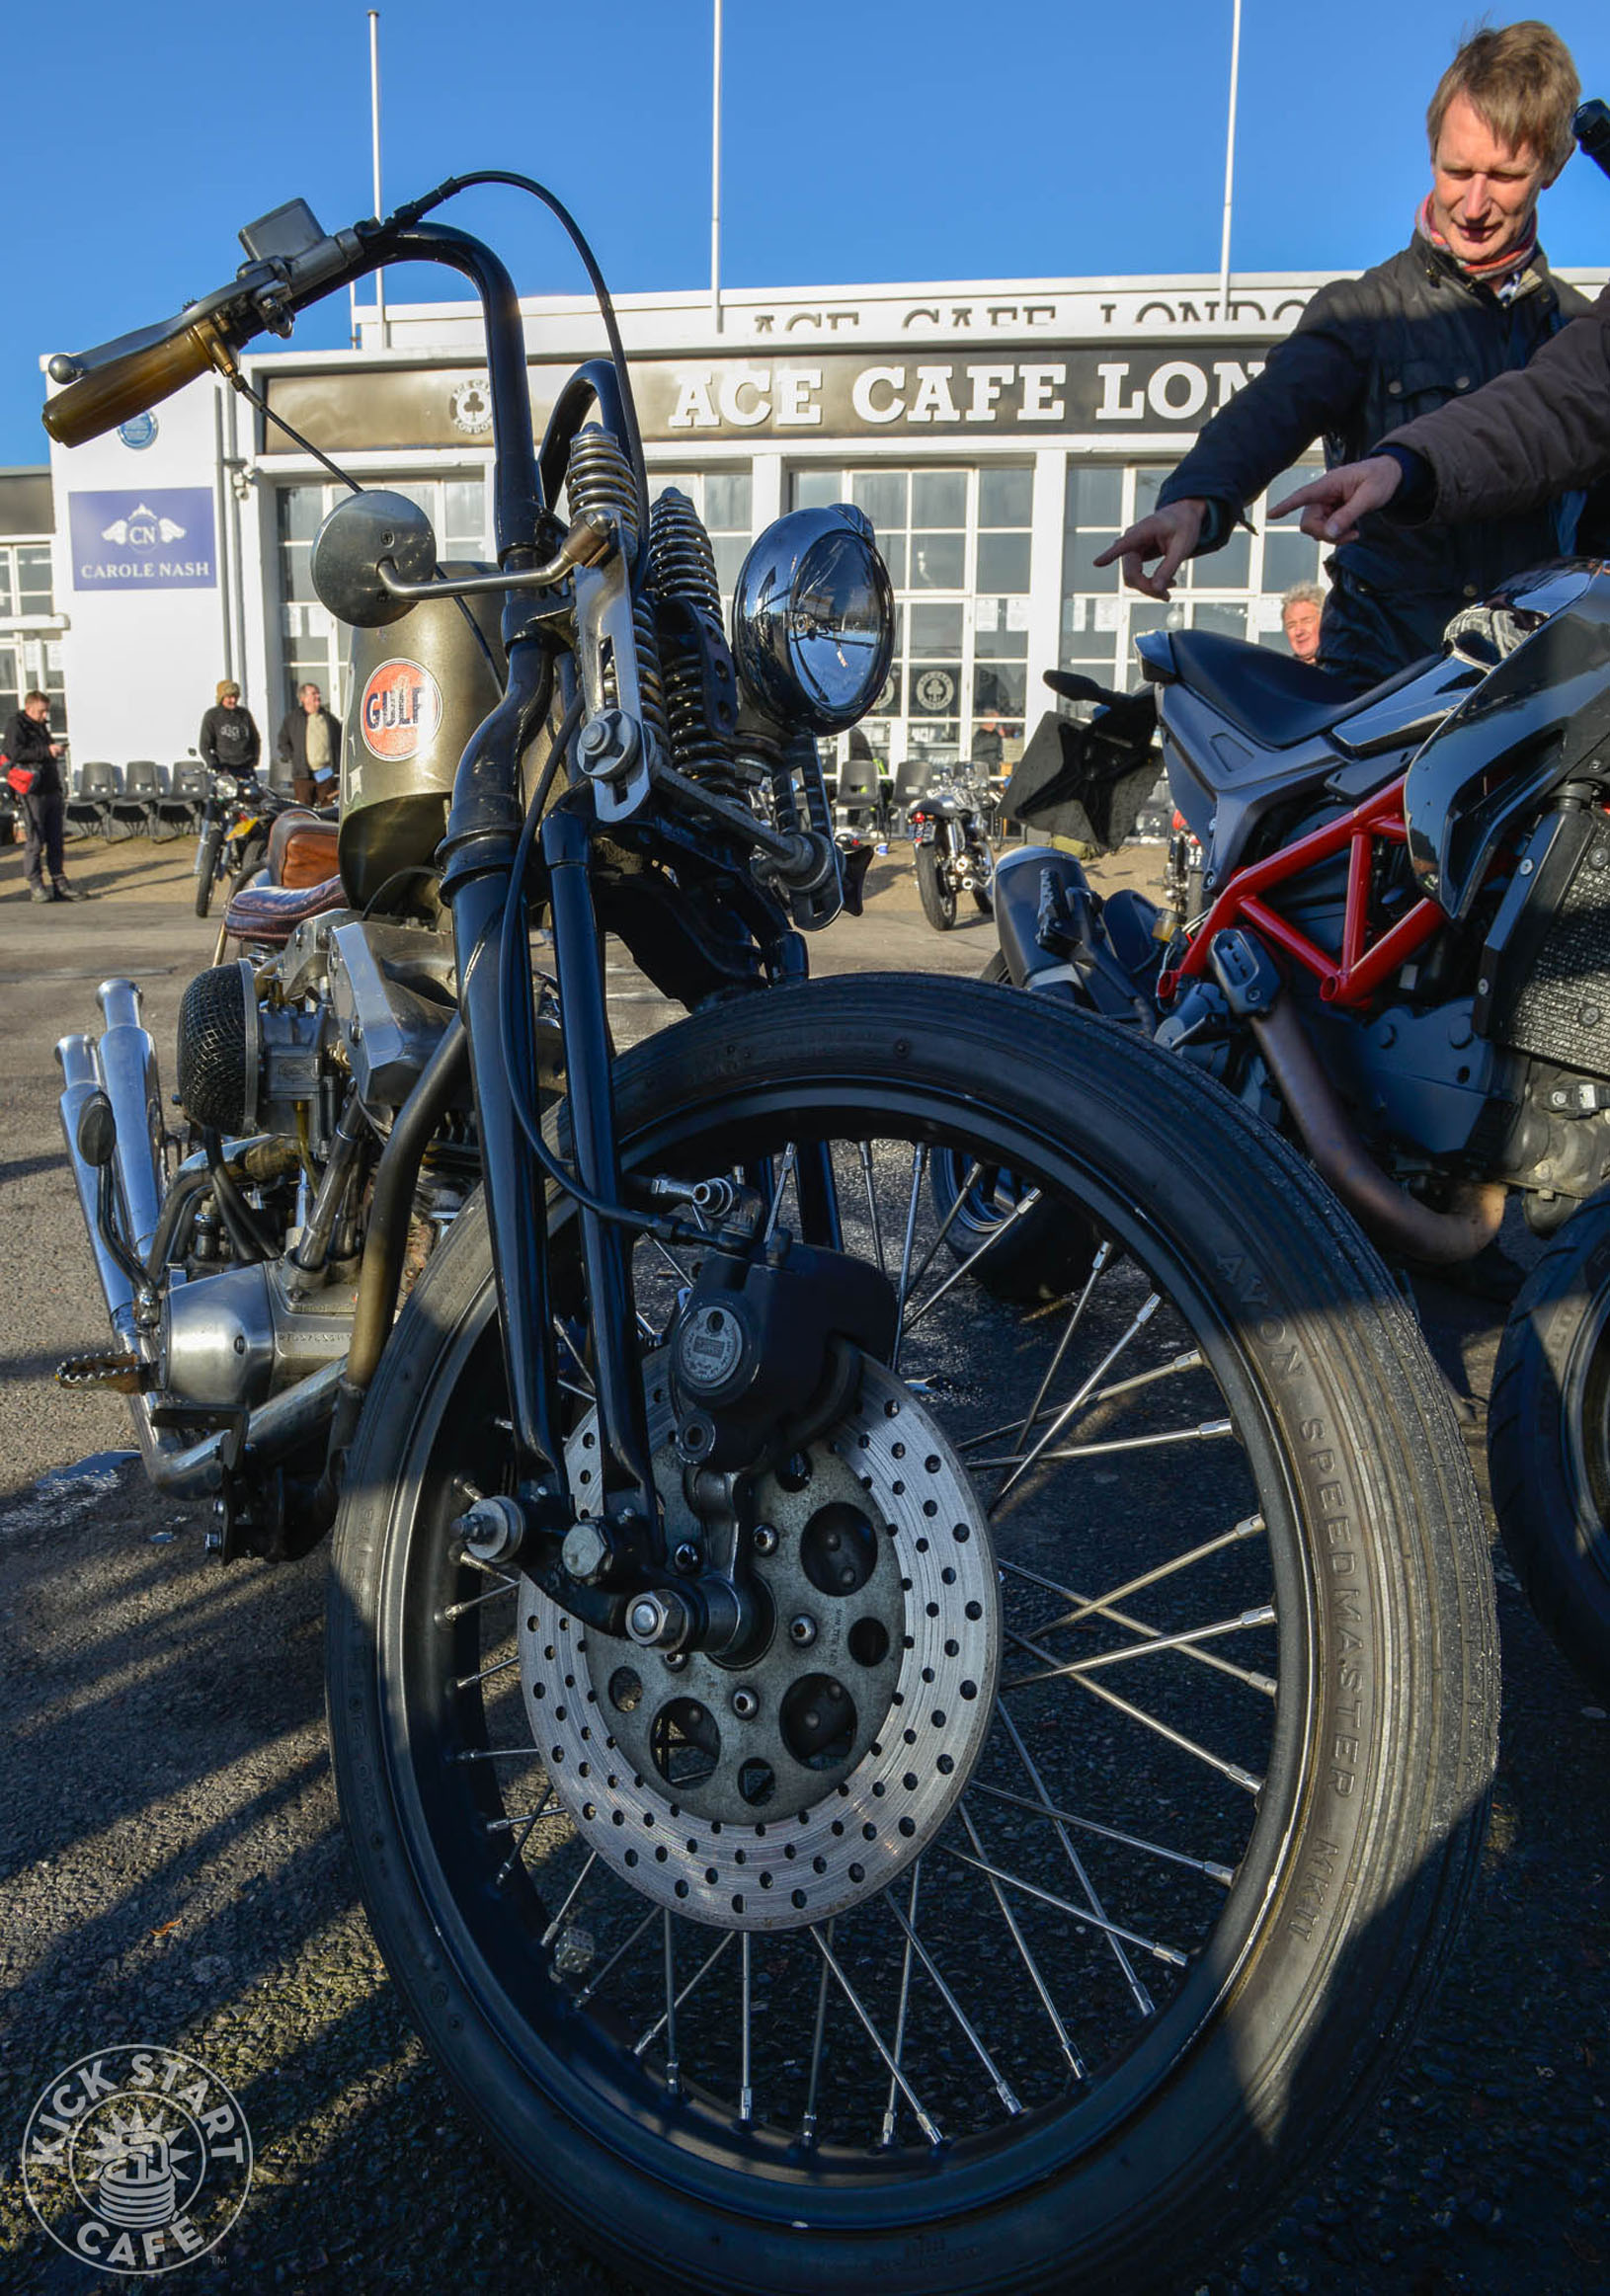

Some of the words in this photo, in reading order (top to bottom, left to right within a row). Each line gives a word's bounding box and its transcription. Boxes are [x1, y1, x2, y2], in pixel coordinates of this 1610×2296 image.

[669, 368, 822, 428] ACE
[852, 364, 1067, 423] CAFE
[129, 526, 155, 544] CN
[81, 563, 154, 579] CAROLE
[159, 561, 209, 577] NASH
[1215, 1252, 1307, 1386] AVON
[1300, 1418, 1364, 1798] SPEEDMASTER
